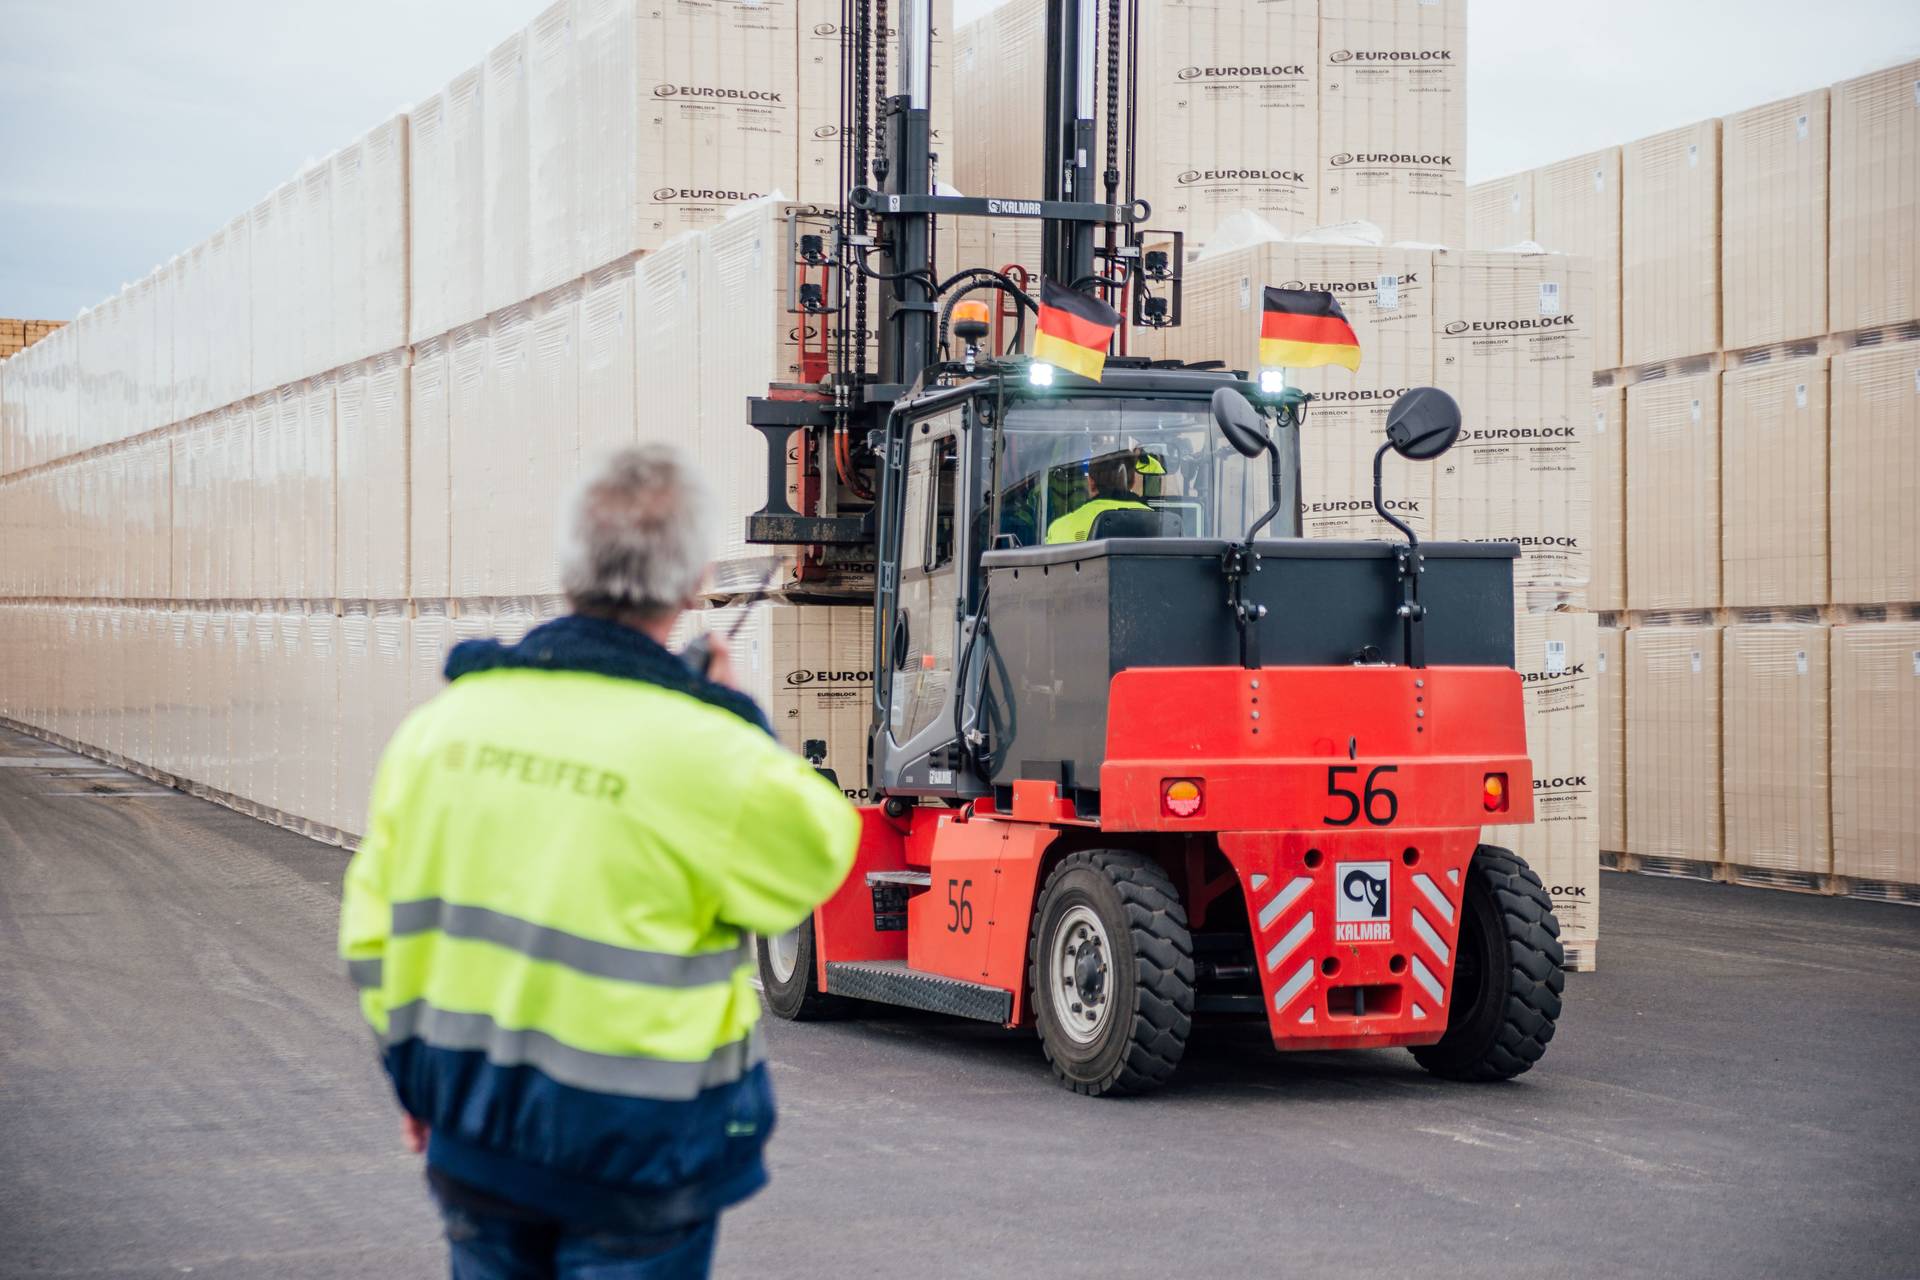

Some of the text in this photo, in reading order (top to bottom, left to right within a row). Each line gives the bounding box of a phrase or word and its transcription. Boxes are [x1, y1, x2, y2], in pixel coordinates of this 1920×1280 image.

[1355, 50, 1452, 61] EUROBLOCK
[1205, 65, 1305, 77] EUROBLOCK
[680, 86, 782, 102] EUROBLOCK
[1356, 153, 1452, 166] EUROBLOCK
[1204, 169, 1305, 182] EUROBLOCK
[680, 189, 769, 200] EUROBLO
[1001, 201, 1041, 215] KALMAR
[1309, 272, 1418, 292] EUROBLCK
[1472, 315, 1574, 331] EUROBLOCK
[1311, 388, 1411, 401] EUROBLOC
[1474, 427, 1575, 440] EUROBLOCK
[1312, 500, 1420, 513] EUROBOCK
[474, 744, 629, 806] PFEIFER
[1323, 765, 1398, 826] 56
[948, 880, 973, 934] 56
[1336, 923, 1391, 941] KALMAR
